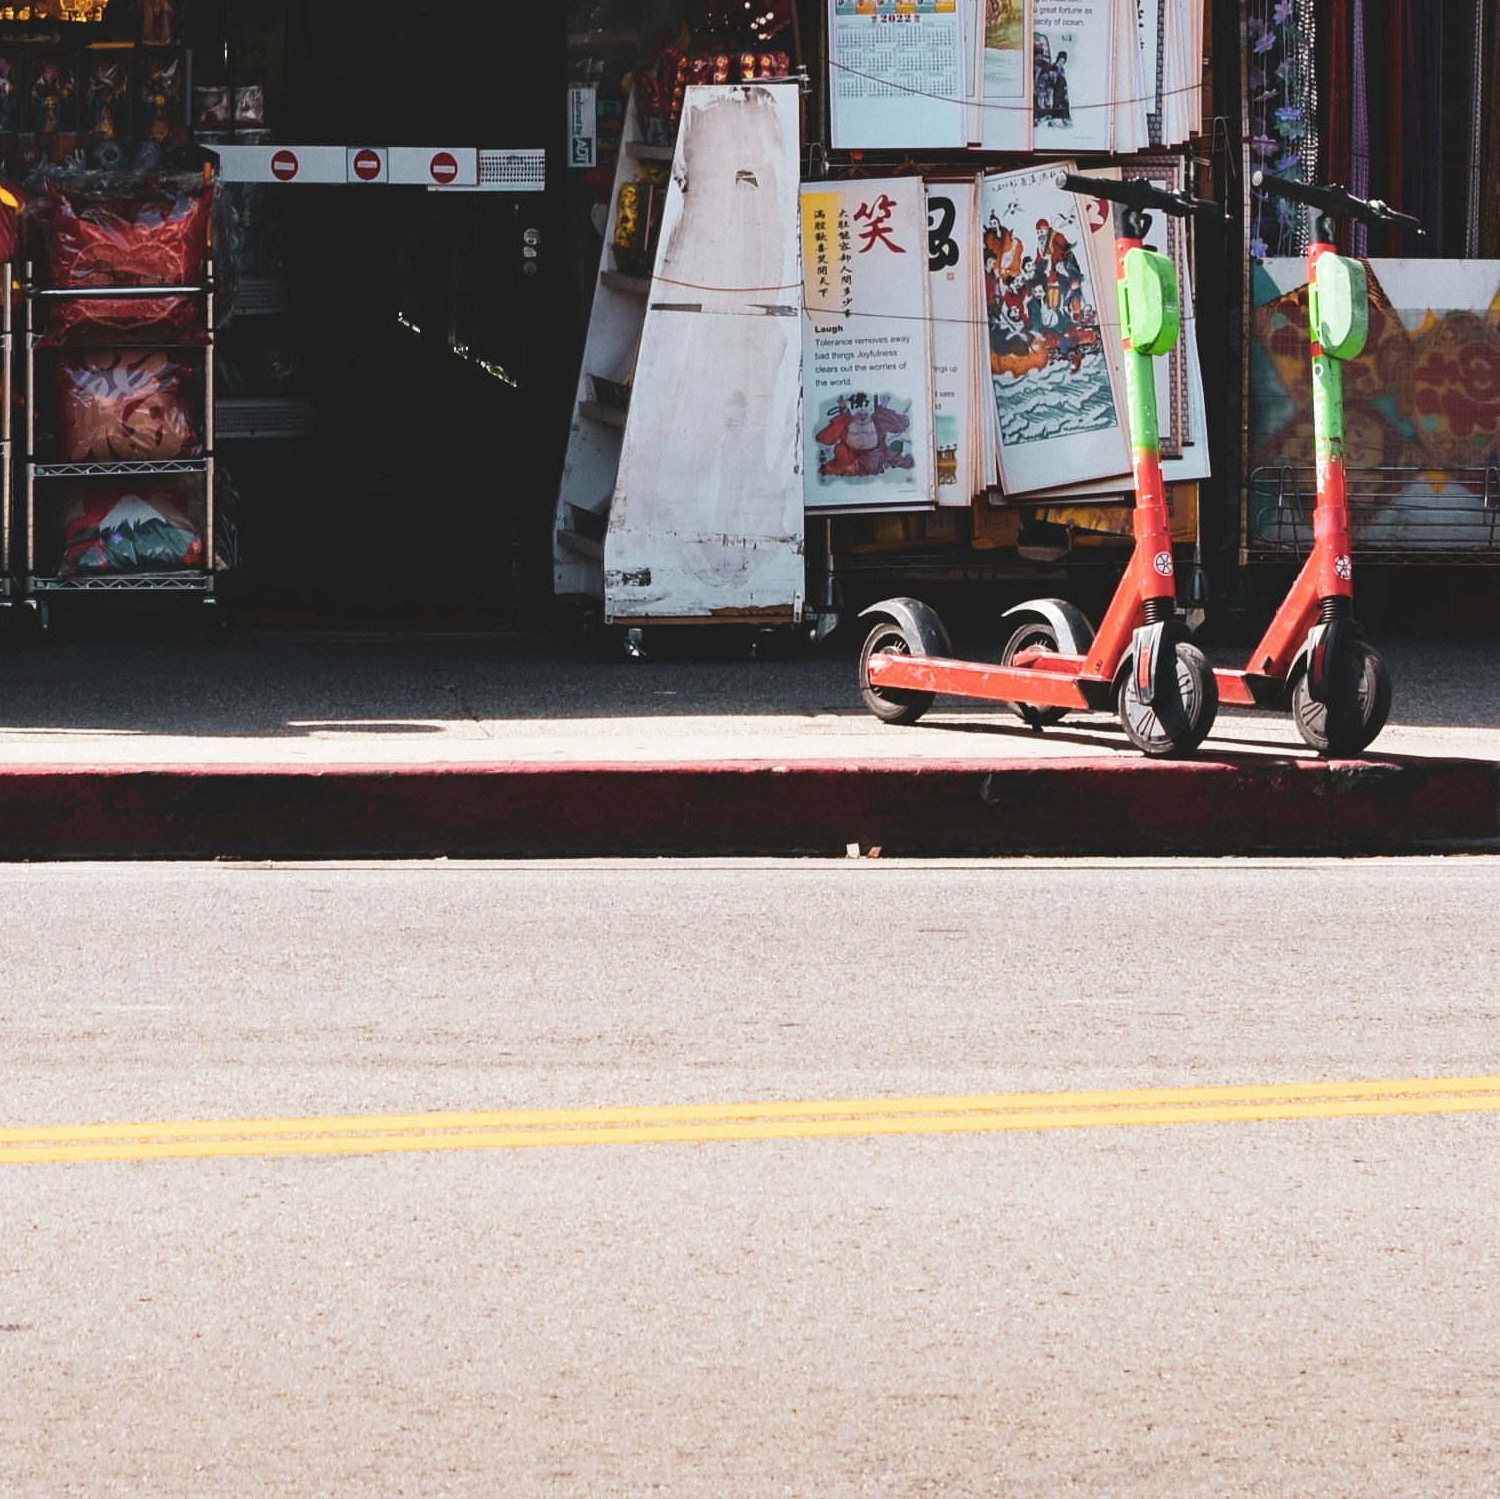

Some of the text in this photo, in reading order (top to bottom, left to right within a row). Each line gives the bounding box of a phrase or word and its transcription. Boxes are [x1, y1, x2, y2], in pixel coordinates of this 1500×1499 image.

[881, 15, 911, 23] 2022
[854, 194, 906, 253] 笑
[815, 325, 843, 336] Laugh
[890, 336, 910, 344] away
[815, 350, 897, 360] bad things Joyfulness
[815, 365, 838, 373] clears
[869, 363, 897, 371] worries
